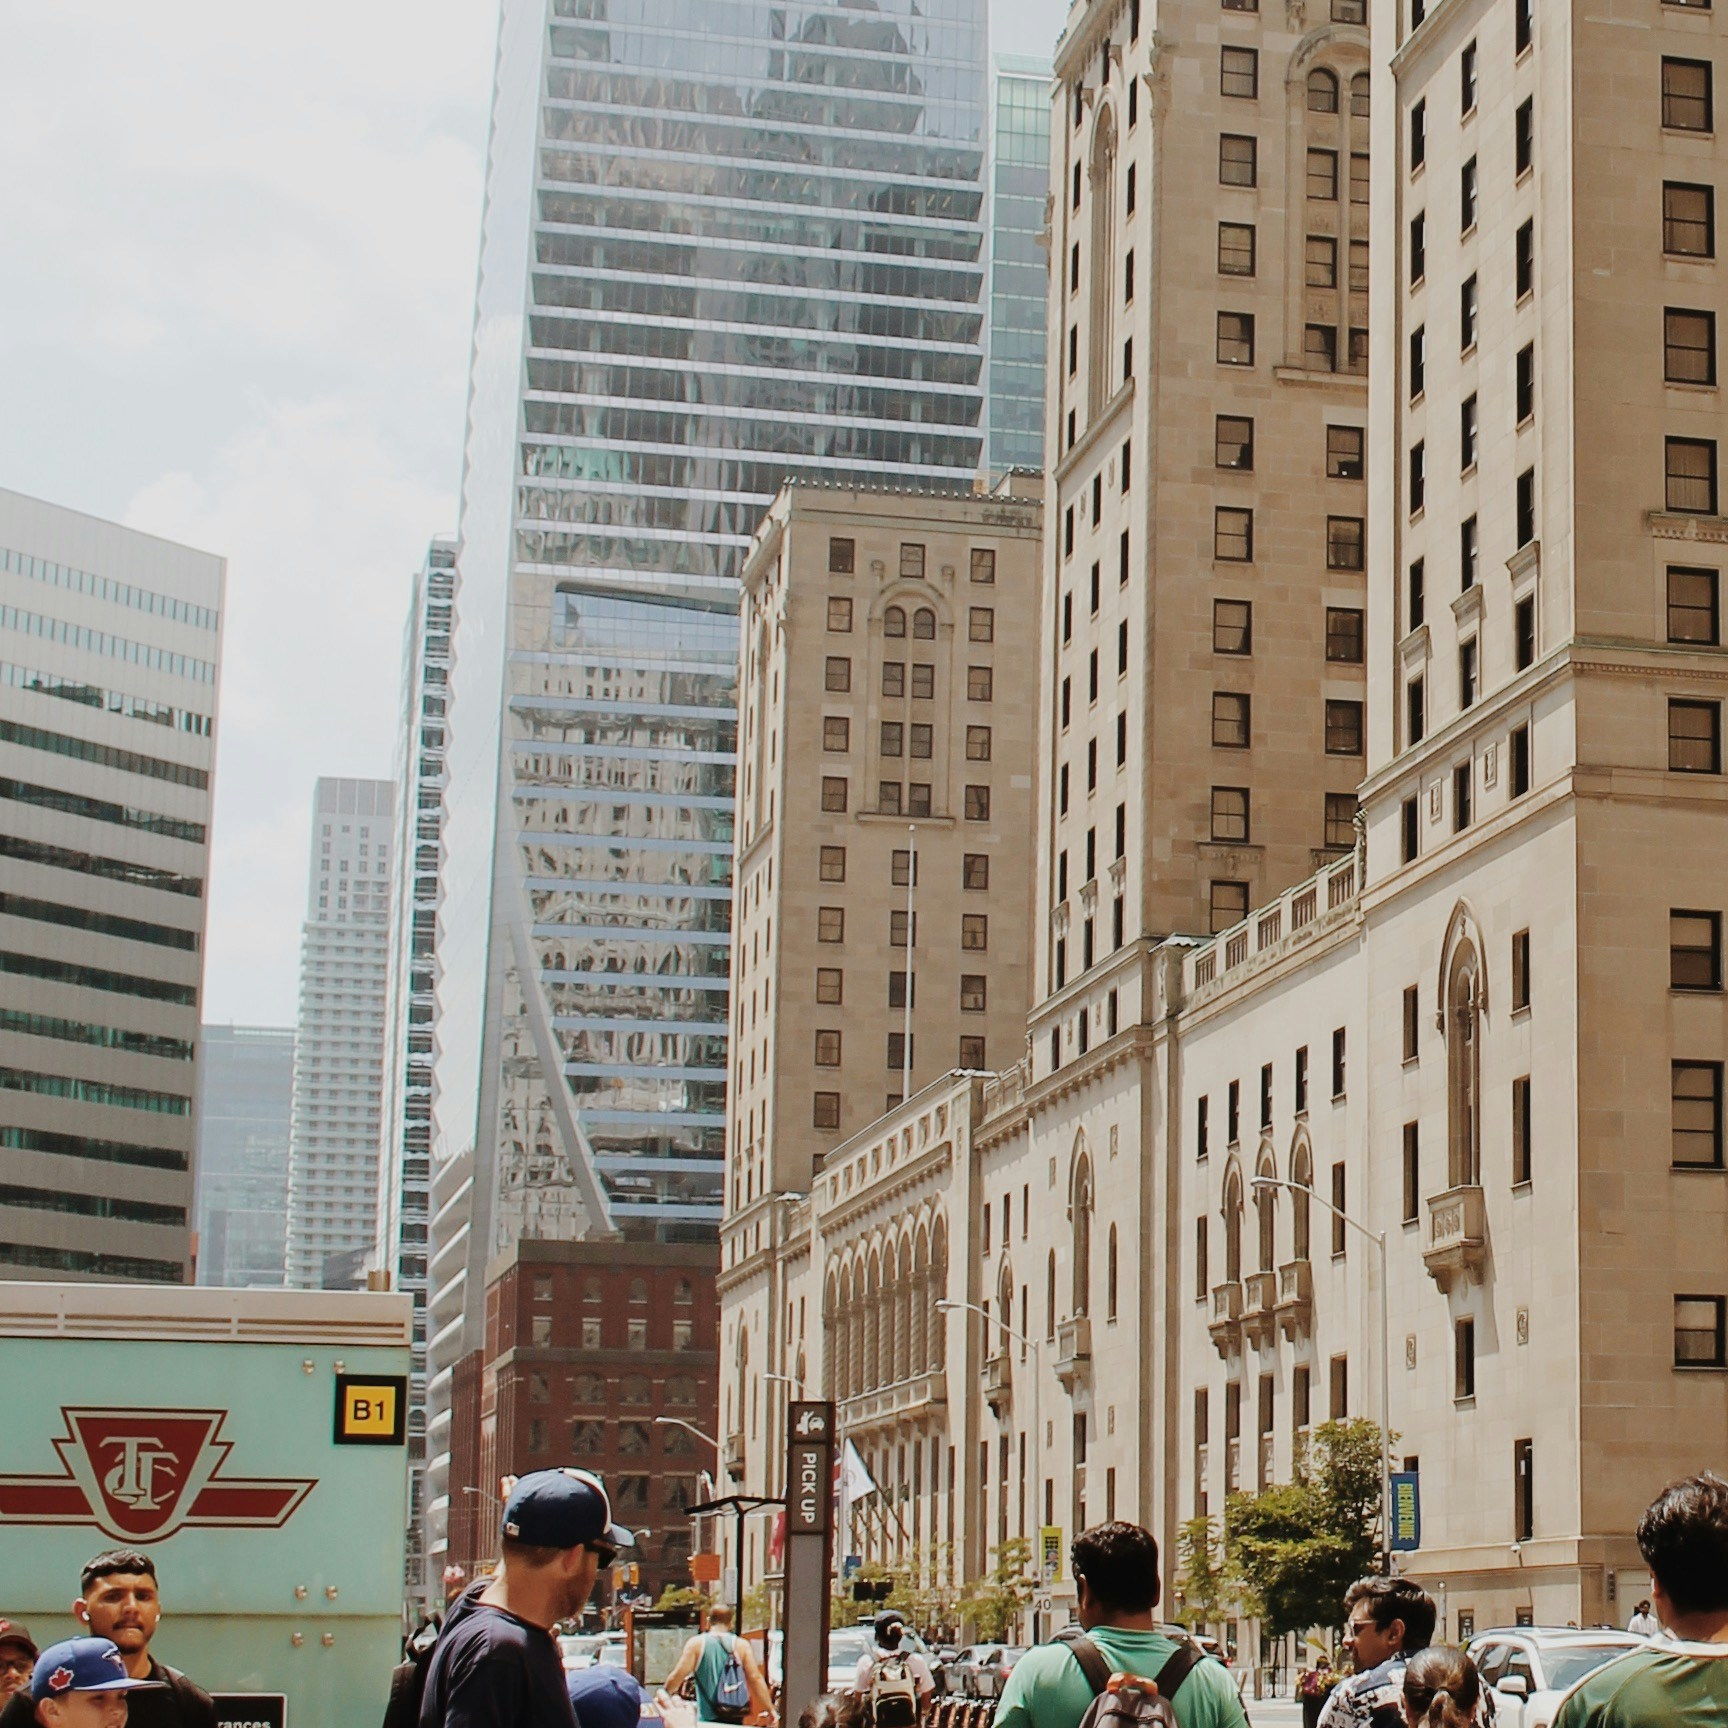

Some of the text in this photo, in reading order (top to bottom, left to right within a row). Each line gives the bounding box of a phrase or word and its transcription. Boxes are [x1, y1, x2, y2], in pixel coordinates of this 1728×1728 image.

[353, 1399, 384, 1421] B1
[800, 1452, 817, 1524] PICK UP
[1034, 1599, 1052, 1611] 40
